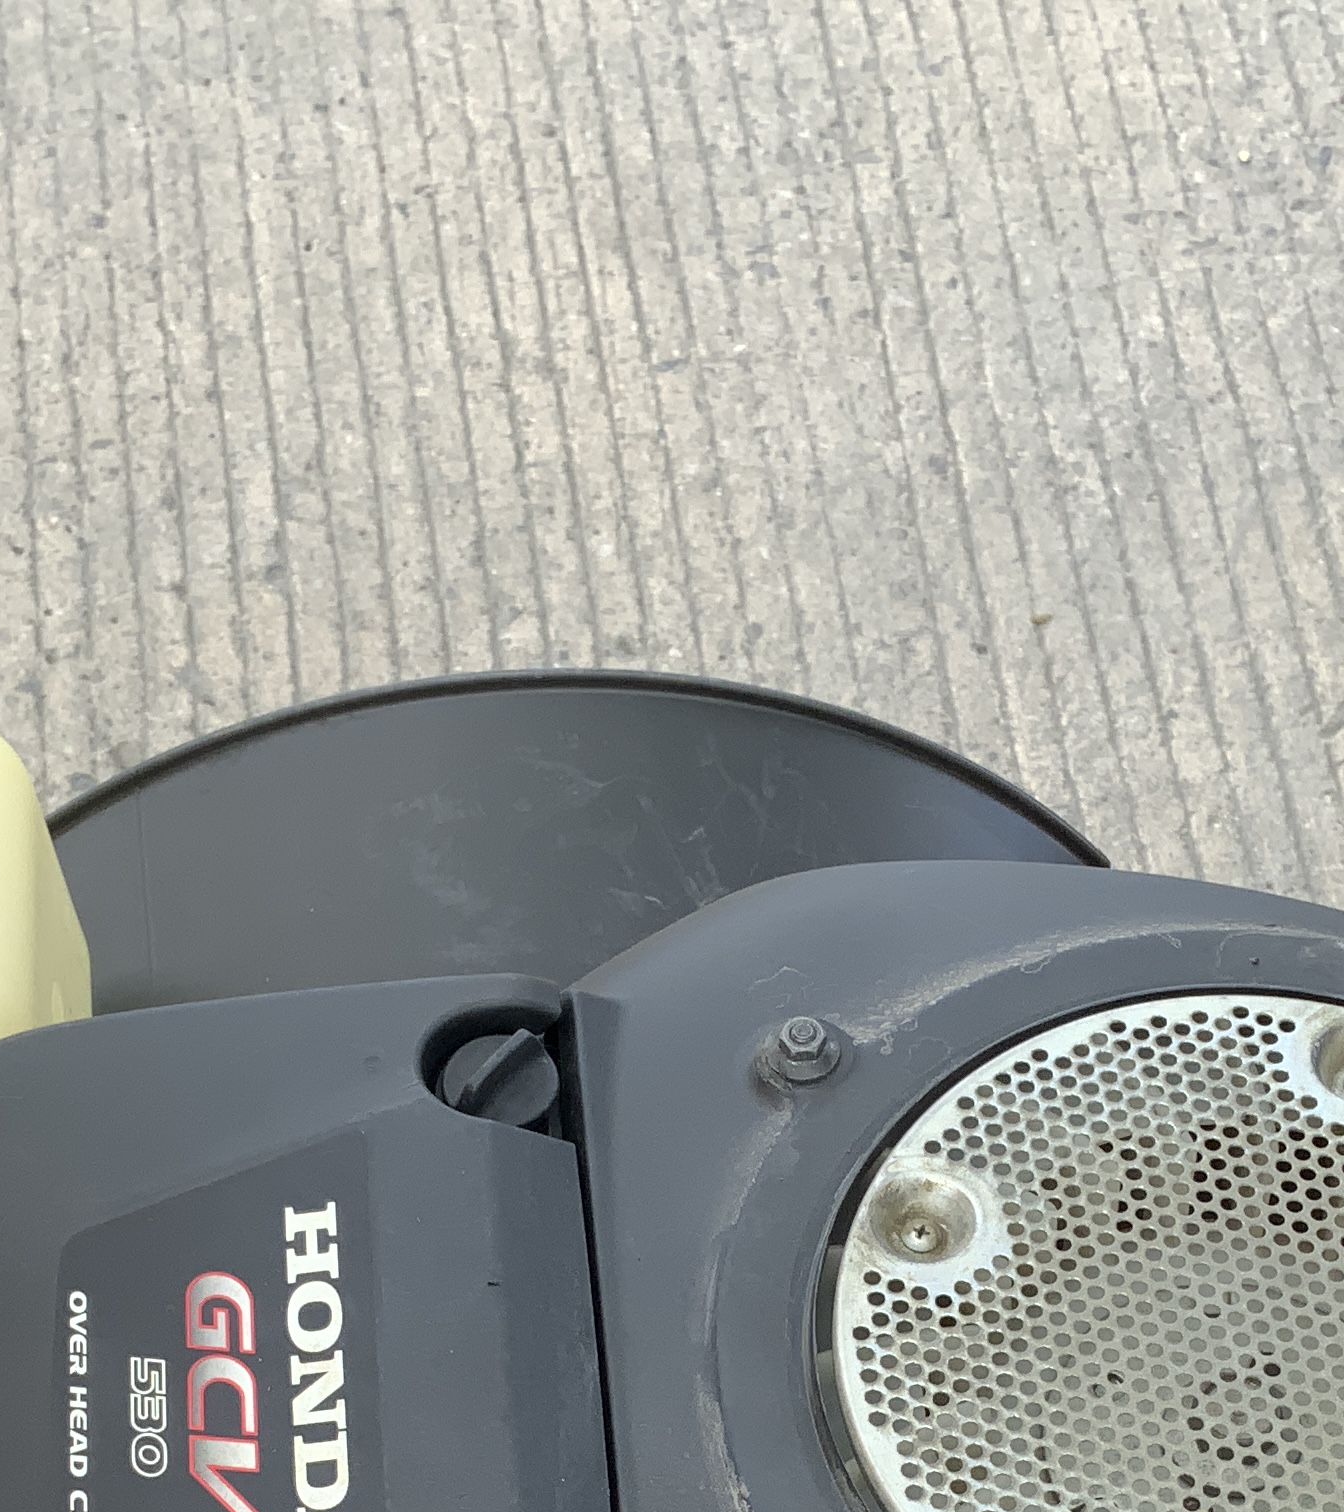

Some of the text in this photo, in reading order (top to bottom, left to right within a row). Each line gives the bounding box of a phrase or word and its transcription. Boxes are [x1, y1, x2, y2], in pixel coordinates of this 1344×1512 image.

[68, 1291, 88, 1375] OVER
[68, 1386, 89, 1478] HEAD
[130, 1357, 168, 1478] 530
